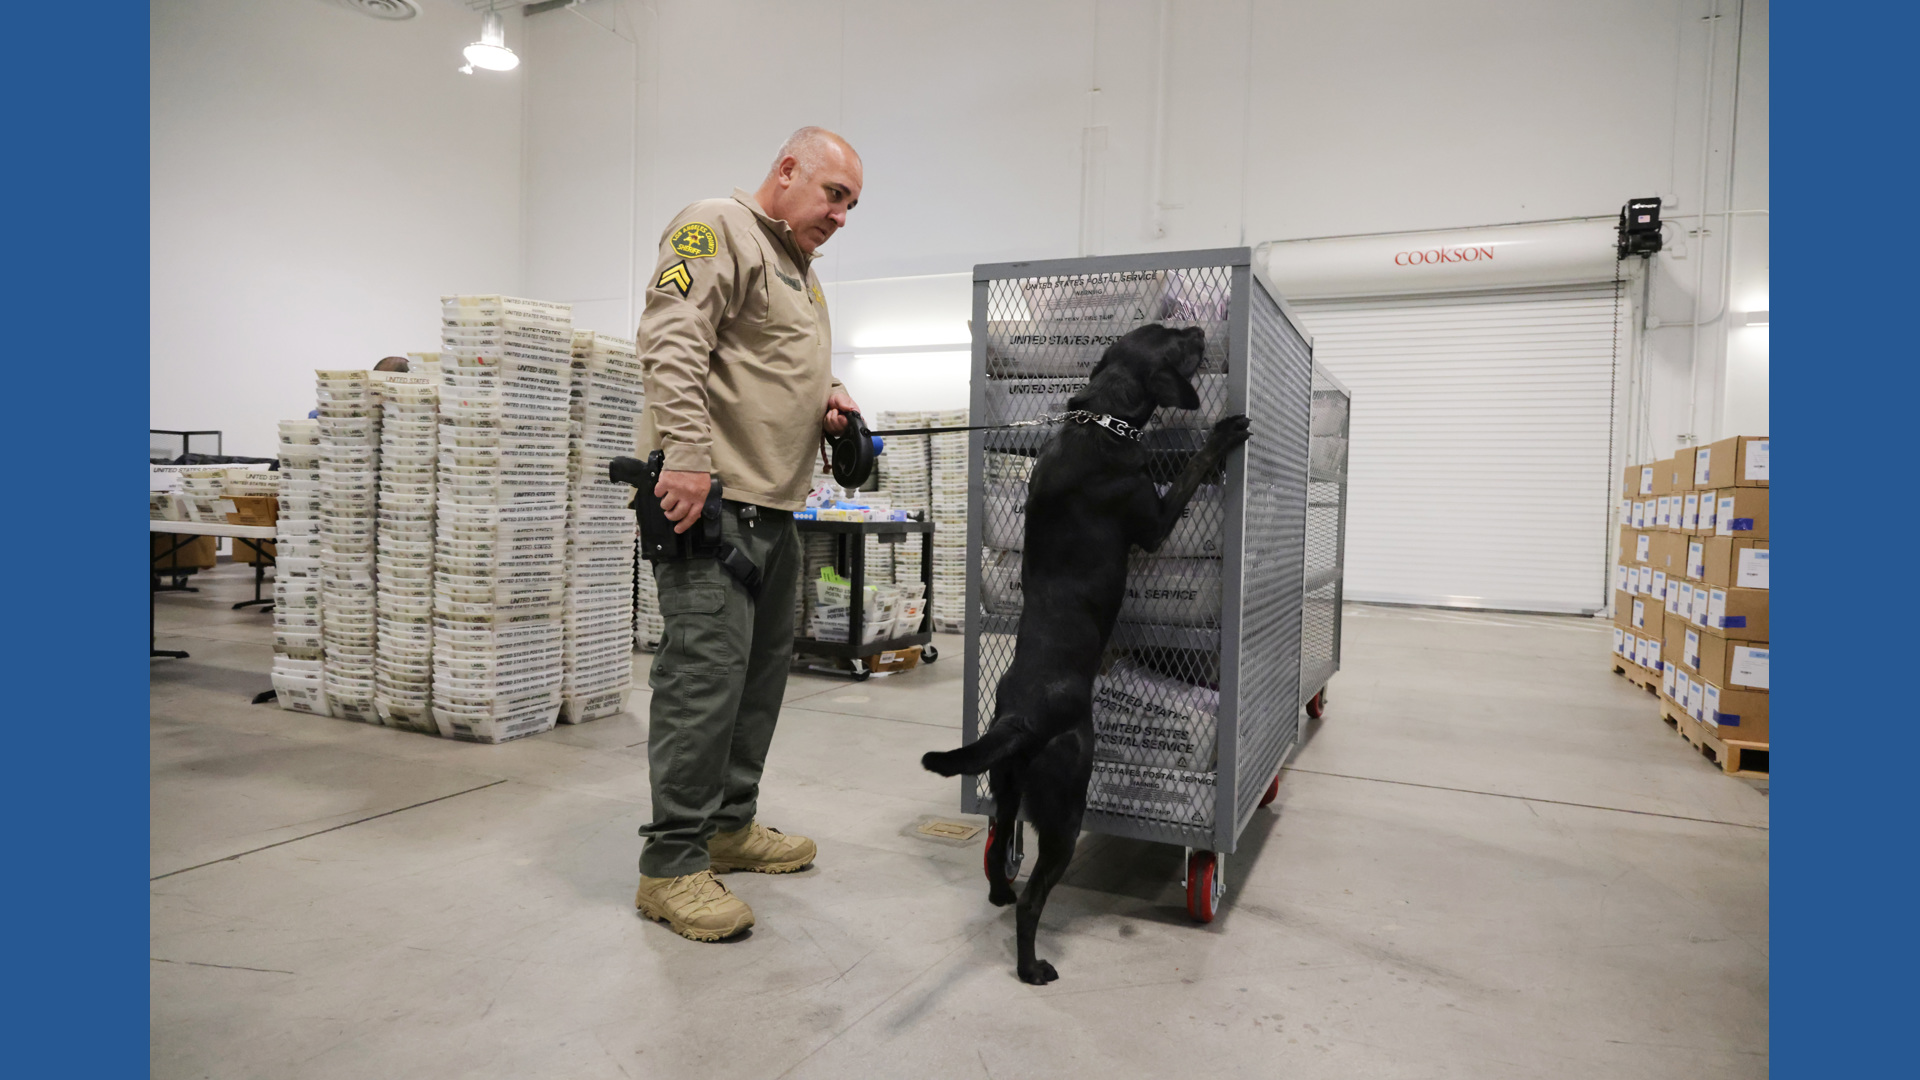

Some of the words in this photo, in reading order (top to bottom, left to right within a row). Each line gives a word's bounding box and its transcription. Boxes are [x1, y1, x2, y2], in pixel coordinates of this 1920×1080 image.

[672, 232, 682, 240] LOS
[683, 224, 708, 233] ANGELES
[706, 232, 714, 253] COUNTY
[677, 244, 702, 255] SHERIFF
[1394, 246, 1494, 266] COOKSON
[1087, 276, 1118, 285] POSTL
[1010, 335, 1047, 345] UNITED
[1049, 336, 1090, 345] STATES
[1091, 335, 1123, 345] POST
[1009, 384, 1045, 394] UNITED
[1047, 384, 1086, 394] STATES
[1144, 589, 1197, 600] SERVICE
[1093, 696, 1133, 714] POSTA
[1100, 686, 1142, 707] UNITED
[1099, 722, 1141, 734] UNITED
[1144, 727, 1190, 740] STATES
[1095, 733, 1139, 747] POSTAL
[1142, 739, 1194, 754] SERVICE
